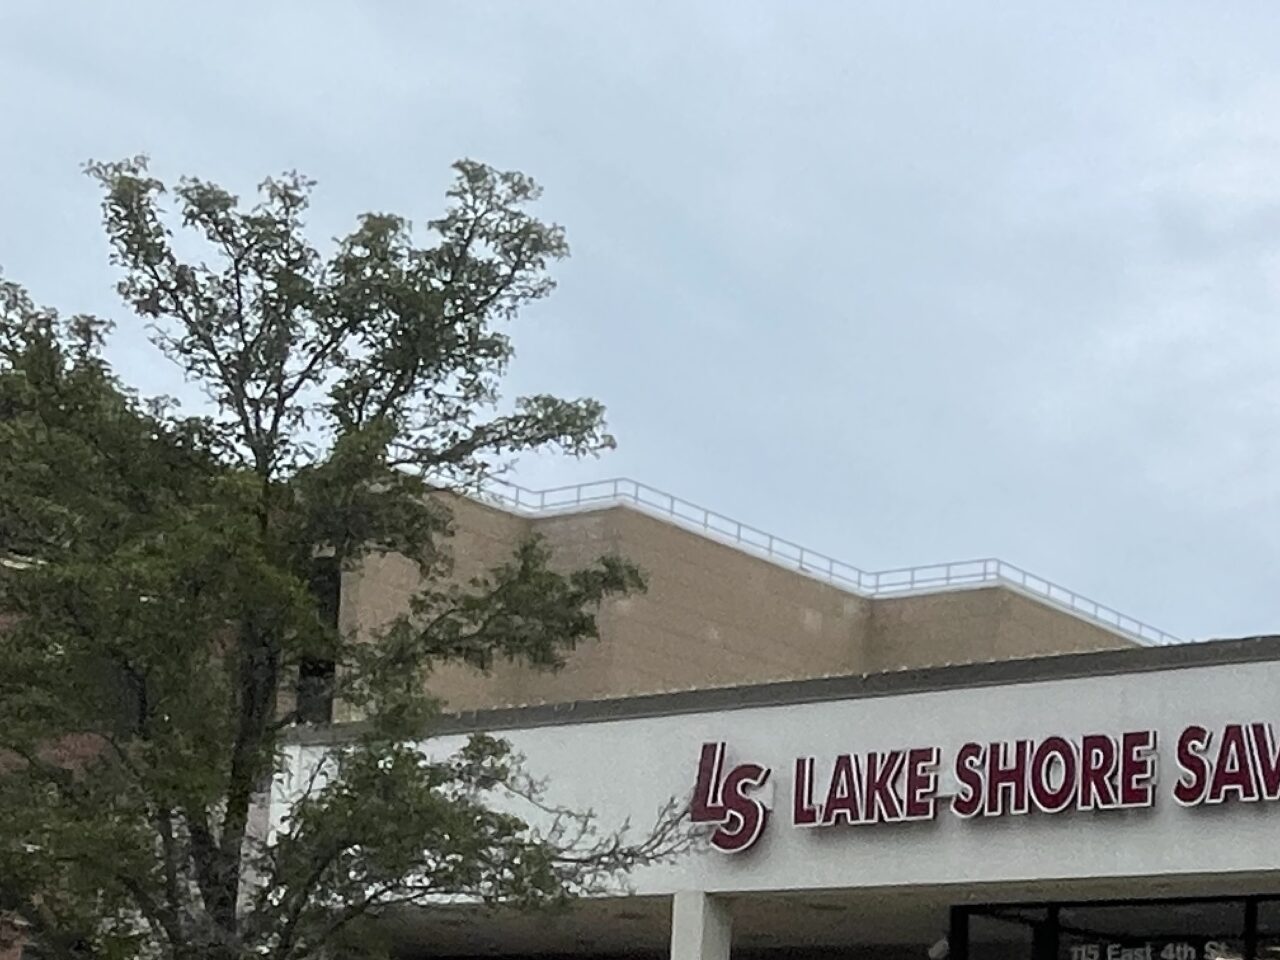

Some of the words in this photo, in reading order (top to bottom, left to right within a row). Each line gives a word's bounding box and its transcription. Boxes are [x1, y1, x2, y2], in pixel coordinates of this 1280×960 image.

[690, 741, 769, 854] LS
[792, 747, 940, 827] LAKE
[953, 731, 1157, 818] SHORE
